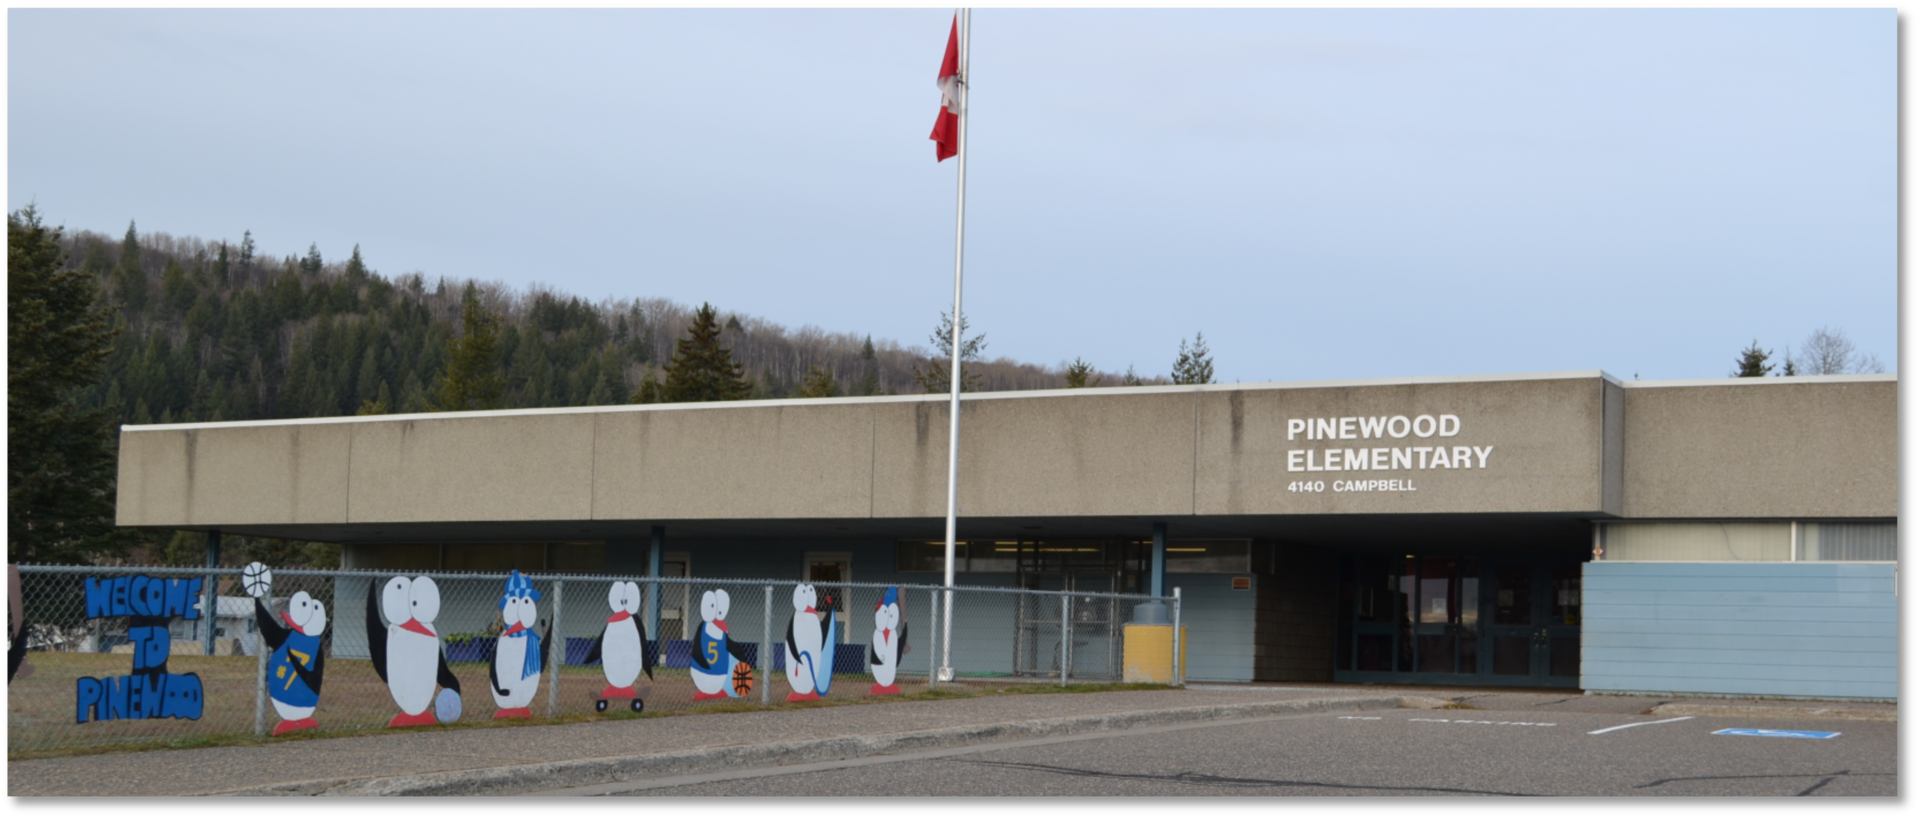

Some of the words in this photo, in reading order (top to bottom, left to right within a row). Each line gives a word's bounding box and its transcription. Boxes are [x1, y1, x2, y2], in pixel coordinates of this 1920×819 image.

[1287, 414, 1461, 441] PINEWOOD
[1287, 446, 1494, 472] ELEMENTARY
[1287, 481, 1325, 492] 4140
[1333, 480, 1417, 492] CAMPBELL
[84, 575, 204, 620] WELCOME
[128, 625, 171, 670] TO
[707, 641, 719, 665] 5
[76, 671, 204, 724] PINEWOOD
